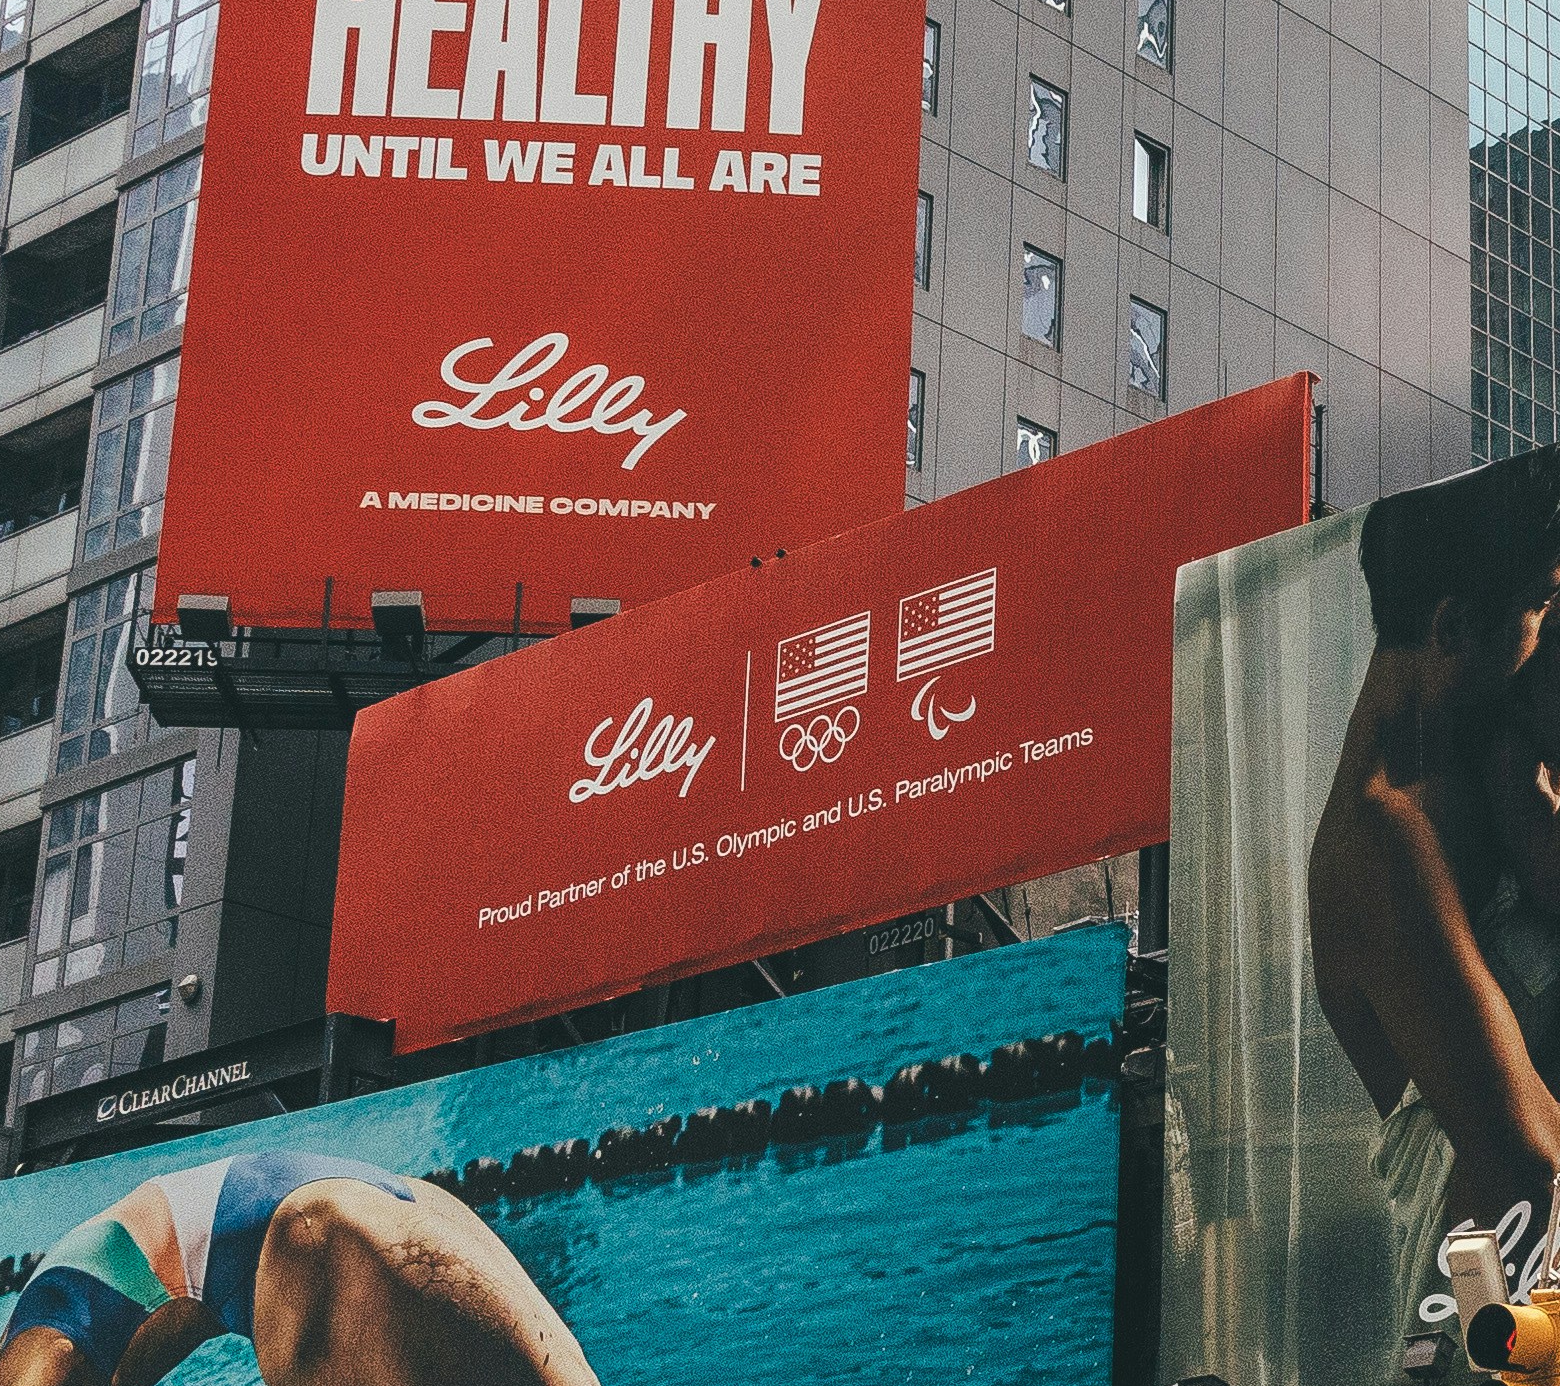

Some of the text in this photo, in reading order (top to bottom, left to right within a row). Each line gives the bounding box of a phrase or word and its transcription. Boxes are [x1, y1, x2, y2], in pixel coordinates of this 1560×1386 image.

[301, 133, 823, 197] UNTIL WE ALL ARE
[412, 332, 688, 471] Lilly
[359, 491, 717, 521] A MEDICINE COMPANY
[568, 696, 716, 804] Lilly
[477, 724, 1094, 929] Proud Partner of the U.S. Olympic and U.S. Paralympic Teams
[868, 918, 935, 957] 022220
